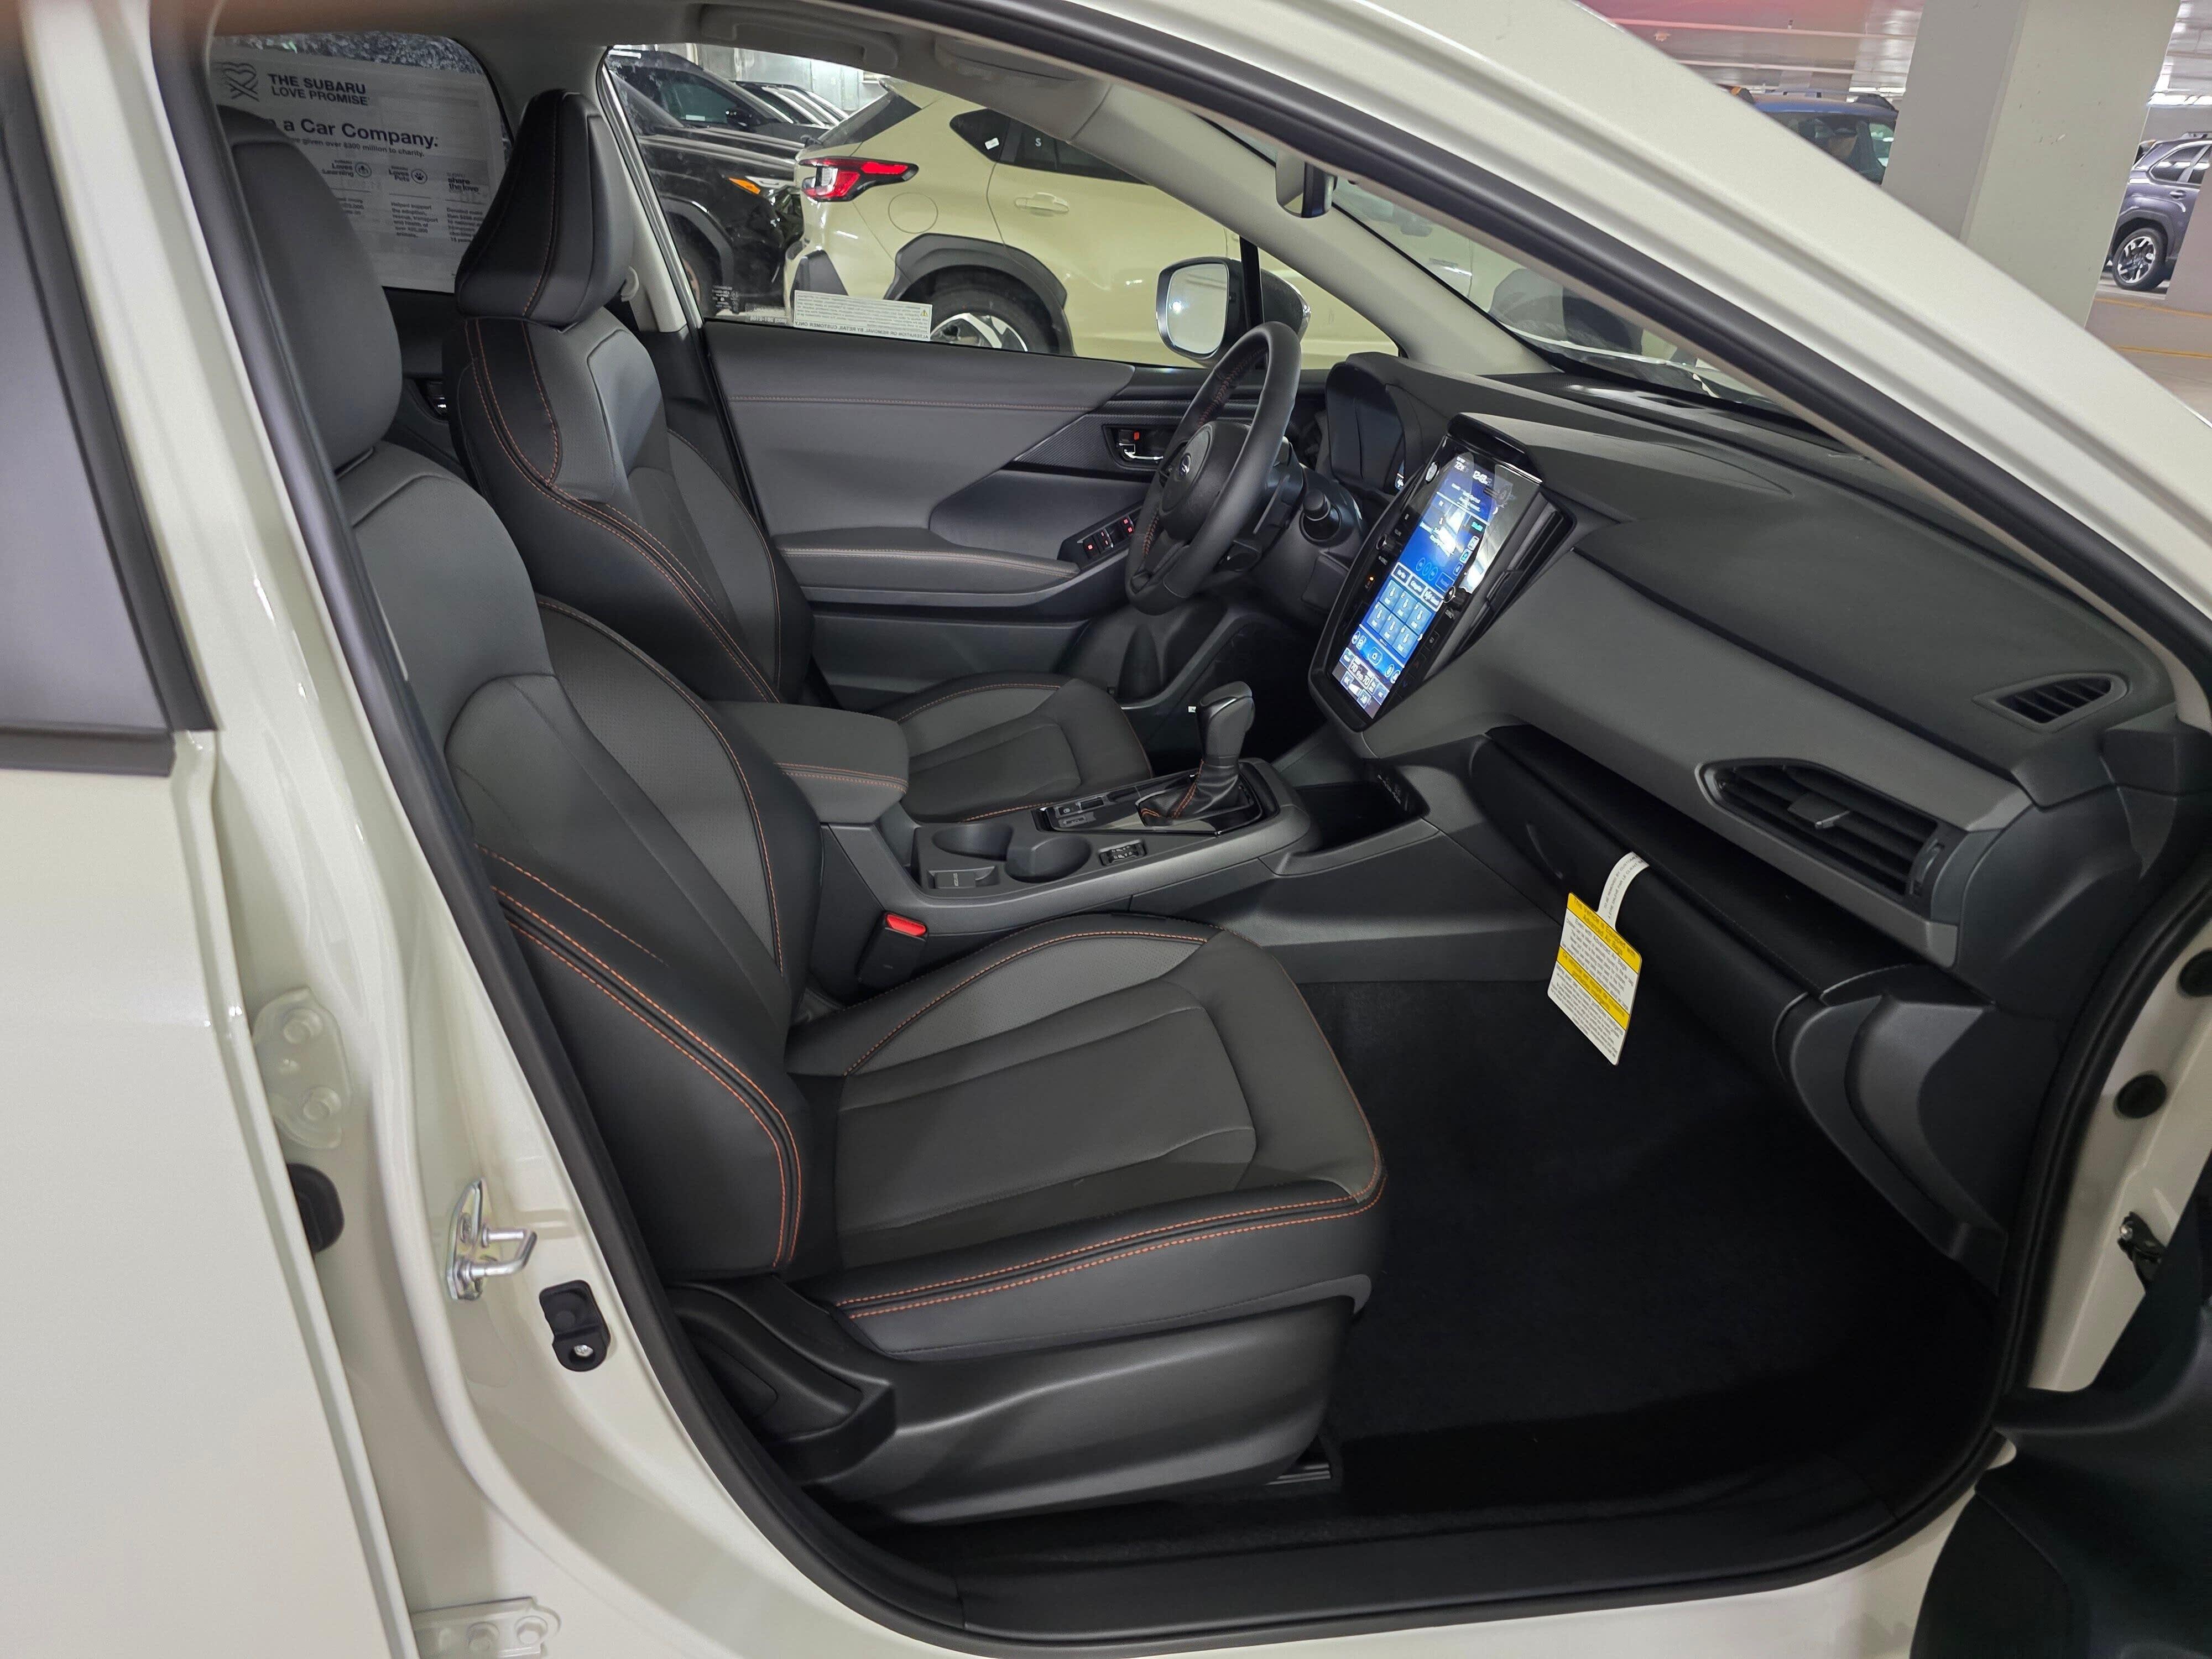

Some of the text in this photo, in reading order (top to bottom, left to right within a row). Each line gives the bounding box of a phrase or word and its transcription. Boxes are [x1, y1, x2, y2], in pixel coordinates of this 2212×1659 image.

[267, 73, 366, 95] THE SUBARU
[271, 86, 306, 98] LOVE
[283, 119, 295, 132] a
[301, 118, 336, 135] Car
[342, 123, 437, 149] Company.
[362, 144, 387, 153] million
[331, 163, 353, 171] Loves
